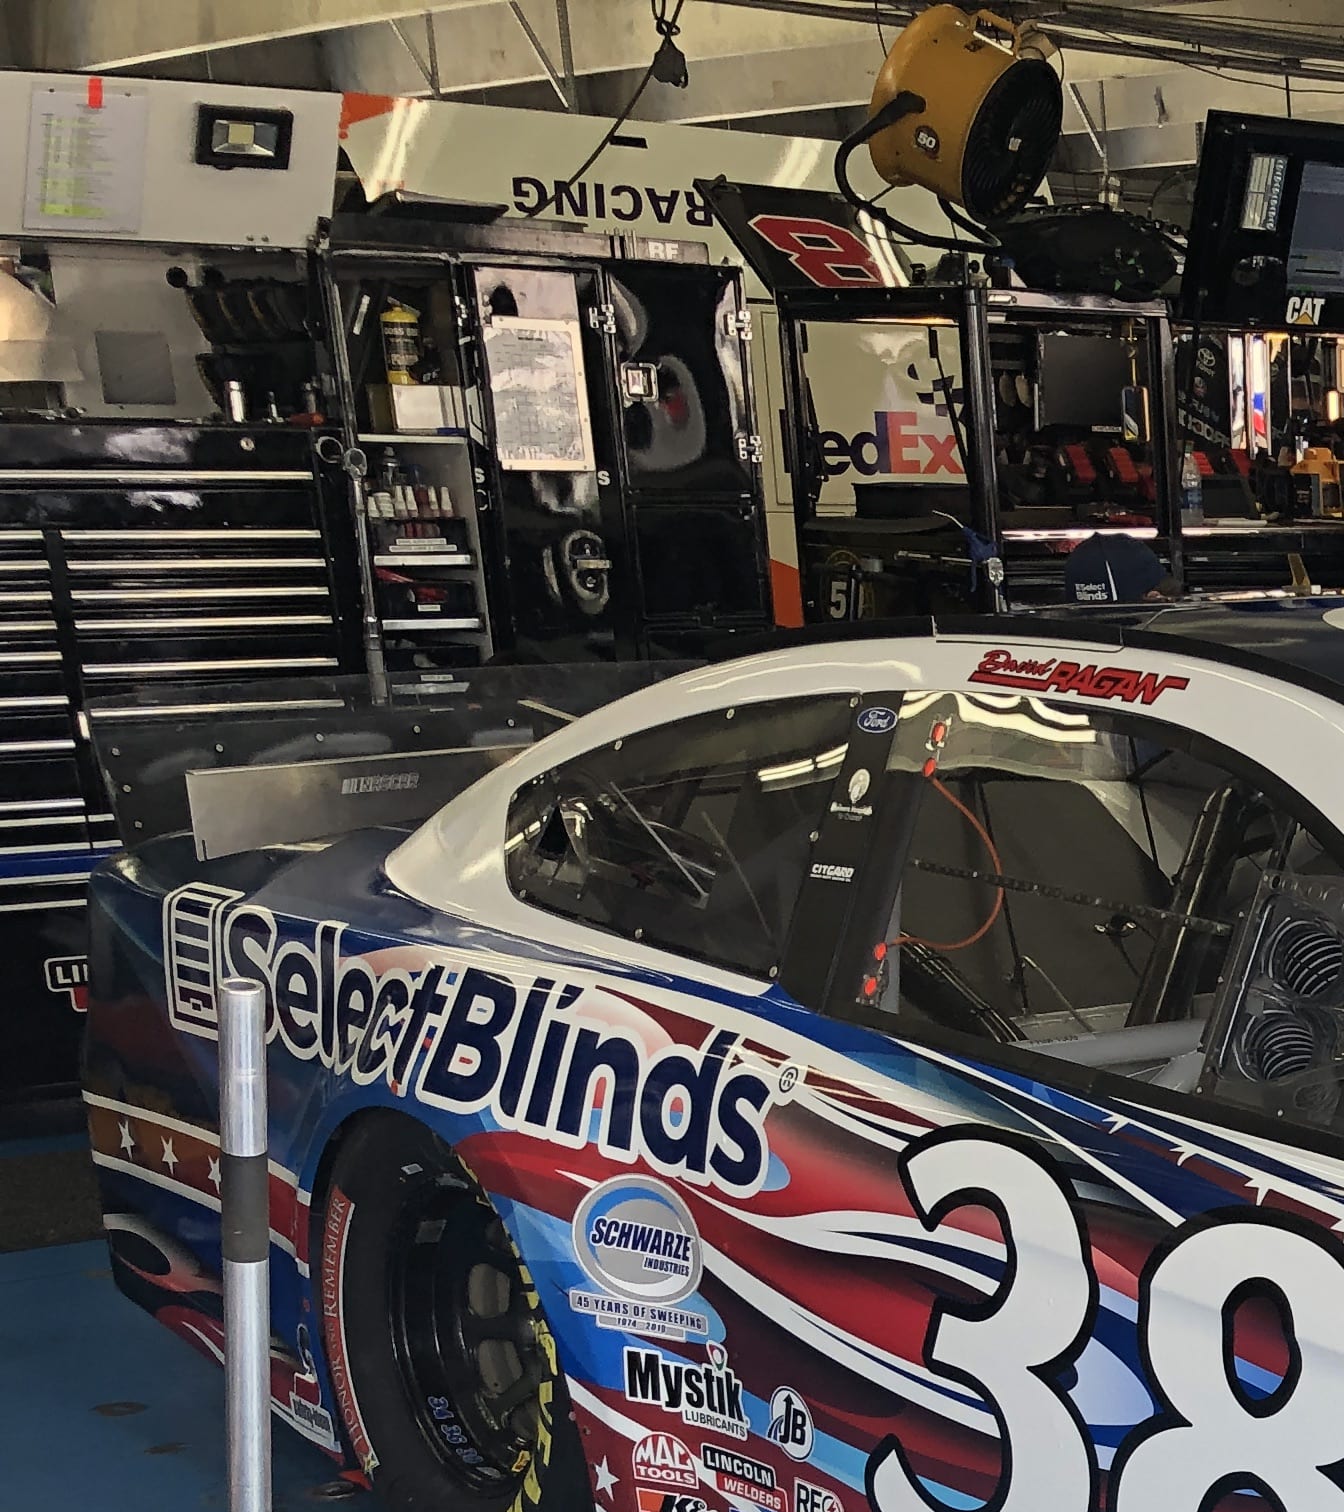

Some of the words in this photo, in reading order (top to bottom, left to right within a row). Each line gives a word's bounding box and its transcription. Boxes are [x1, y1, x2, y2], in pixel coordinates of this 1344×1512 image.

[511, 176, 715, 227] RACING
[1286, 297, 1326, 326] CAT
[863, 710, 891, 729] Ford
[811, 863, 856, 878] CITGARD
[323, 1196, 347, 1319] REMEMBER
[591, 1218, 692, 1262] SCHWARZE
[643, 1257, 689, 1277] INDUSTRIES
[576, 1295, 591, 1308] 45
[593, 1297, 629, 1316] YEARS
[633, 1305, 646, 1319] OF
[649, 1308, 703, 1330] SWEEPING
[626, 1345, 746, 1422] Mystik
[332, 1357, 363, 1446] HONOR
[684, 1411, 746, 1438] LUBRICANTS
[779, 1398, 807, 1445] JB
[636, 1435, 692, 1468] MAC
[706, 1449, 773, 1487] LINCOLN
[636, 1464, 696, 1485] TOOLS
[723, 1476, 782, 1511] WELDERS
